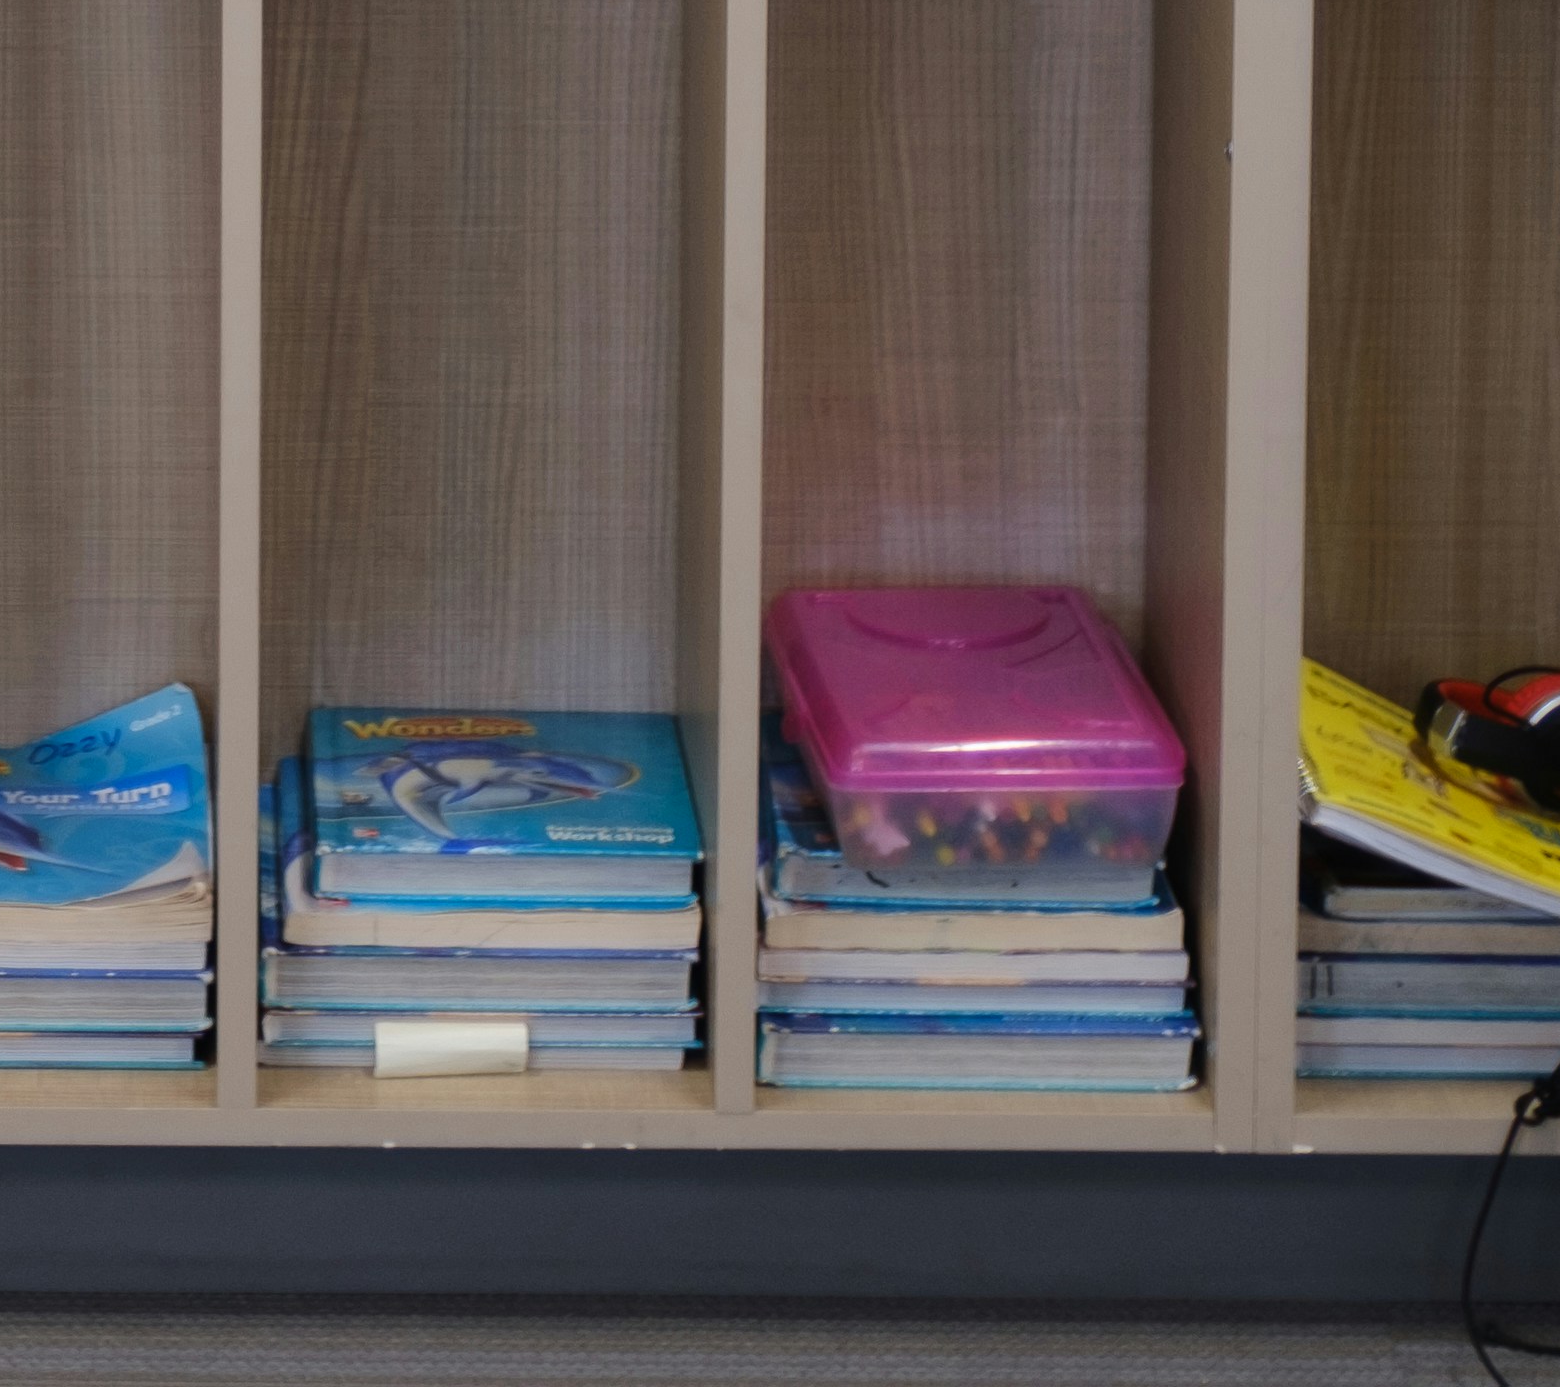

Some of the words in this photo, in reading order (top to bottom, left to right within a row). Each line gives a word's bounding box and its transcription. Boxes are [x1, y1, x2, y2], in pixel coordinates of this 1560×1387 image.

[345, 715, 538, 740] Wonders
[27, 728, 122, 766] Ozzy
[0, 790, 81, 804] Your
[89, 781, 173, 804] Turn
